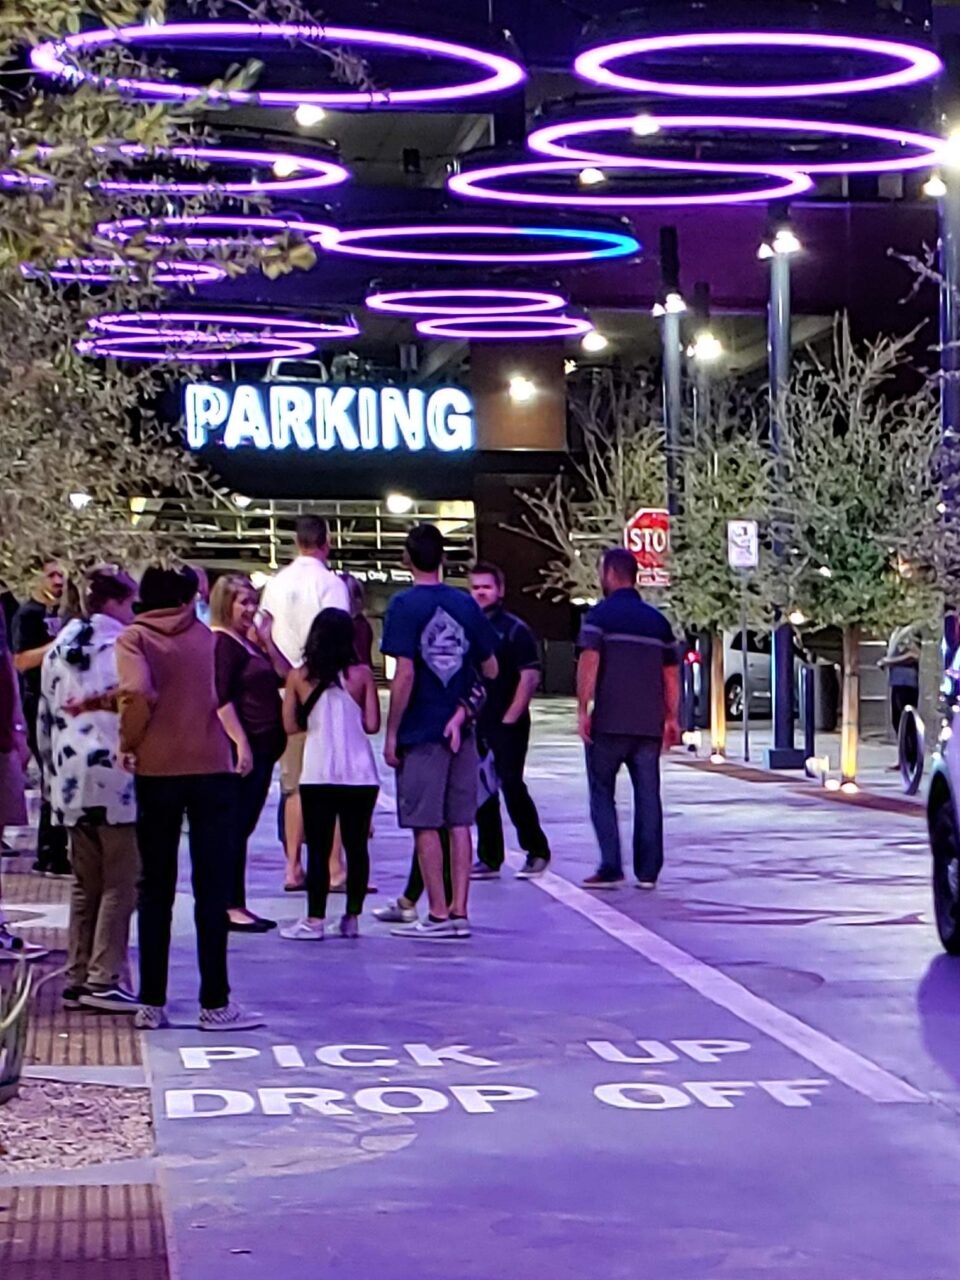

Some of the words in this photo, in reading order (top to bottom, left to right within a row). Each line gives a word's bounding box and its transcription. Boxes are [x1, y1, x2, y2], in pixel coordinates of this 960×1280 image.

[184, 383, 475, 450] PARKING
[630, 527, 669, 552] STO
[178, 1043, 501, 1069] PICK
[589, 1039, 752, 1064] UP
[165, 1084, 540, 1118] DROP
[593, 1079, 830, 1110] OFF
